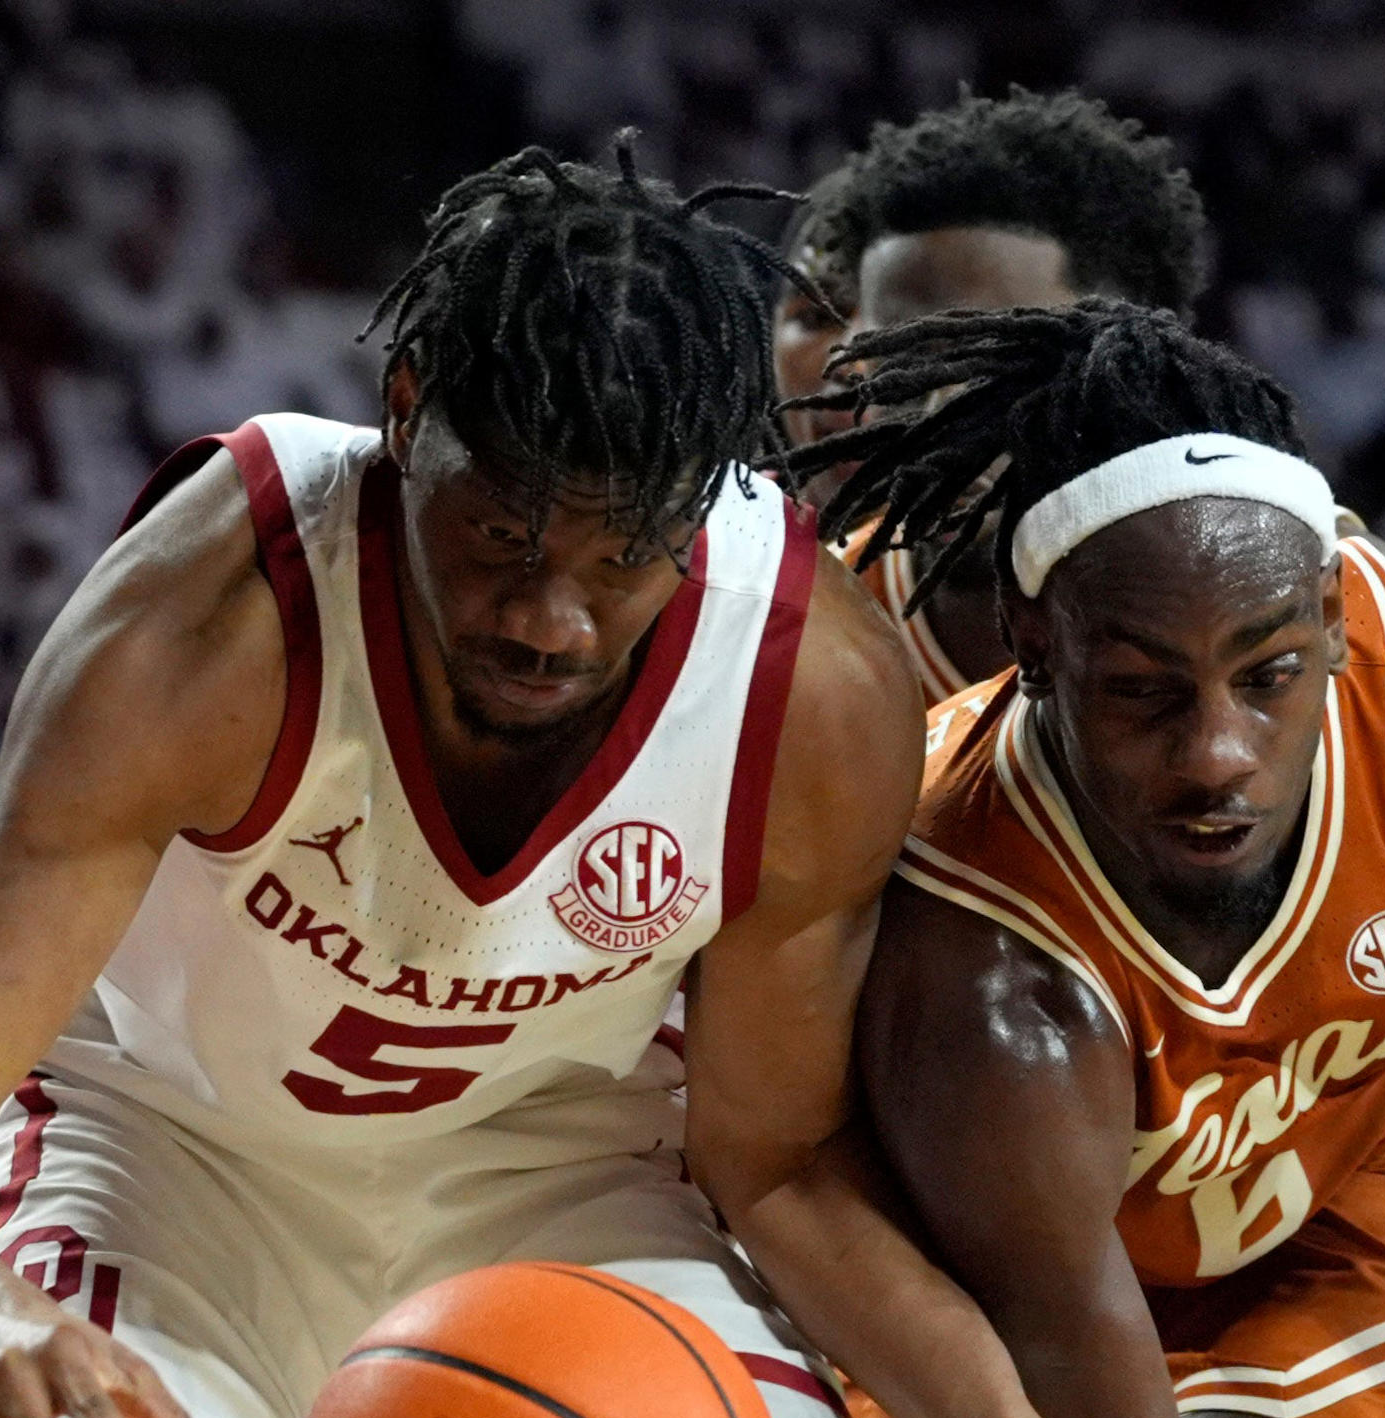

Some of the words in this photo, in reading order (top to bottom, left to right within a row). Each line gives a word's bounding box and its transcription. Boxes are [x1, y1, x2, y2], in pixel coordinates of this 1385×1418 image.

[585, 825, 679, 918] SEC
[568, 905, 688, 949] GRADUATE
[280, 1003, 519, 1117] 5
